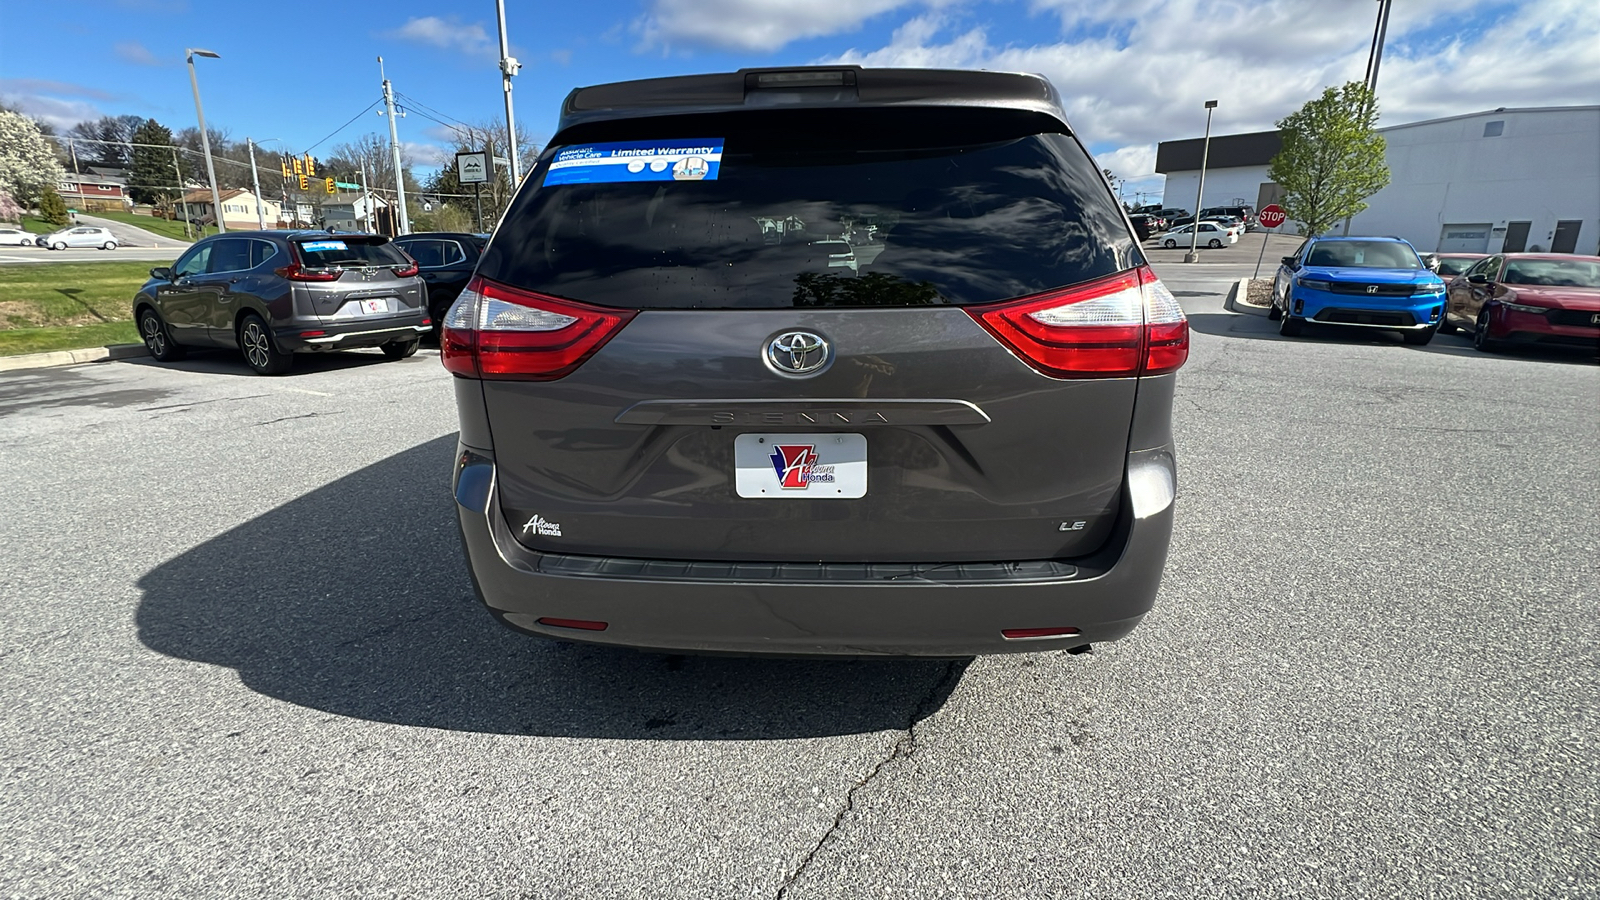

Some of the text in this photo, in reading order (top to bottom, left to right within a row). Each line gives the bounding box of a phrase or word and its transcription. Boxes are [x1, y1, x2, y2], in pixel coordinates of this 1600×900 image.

[558, 153, 584, 161] Vehicle
[611, 147, 714, 157] Limited Warranty
[1260, 211, 1285, 222] STOP
[711, 411, 889, 424] SIENNA
[802, 472, 834, 483] Honda
[1059, 520, 1087, 531] LE
[538, 528, 562, 537] Honda
